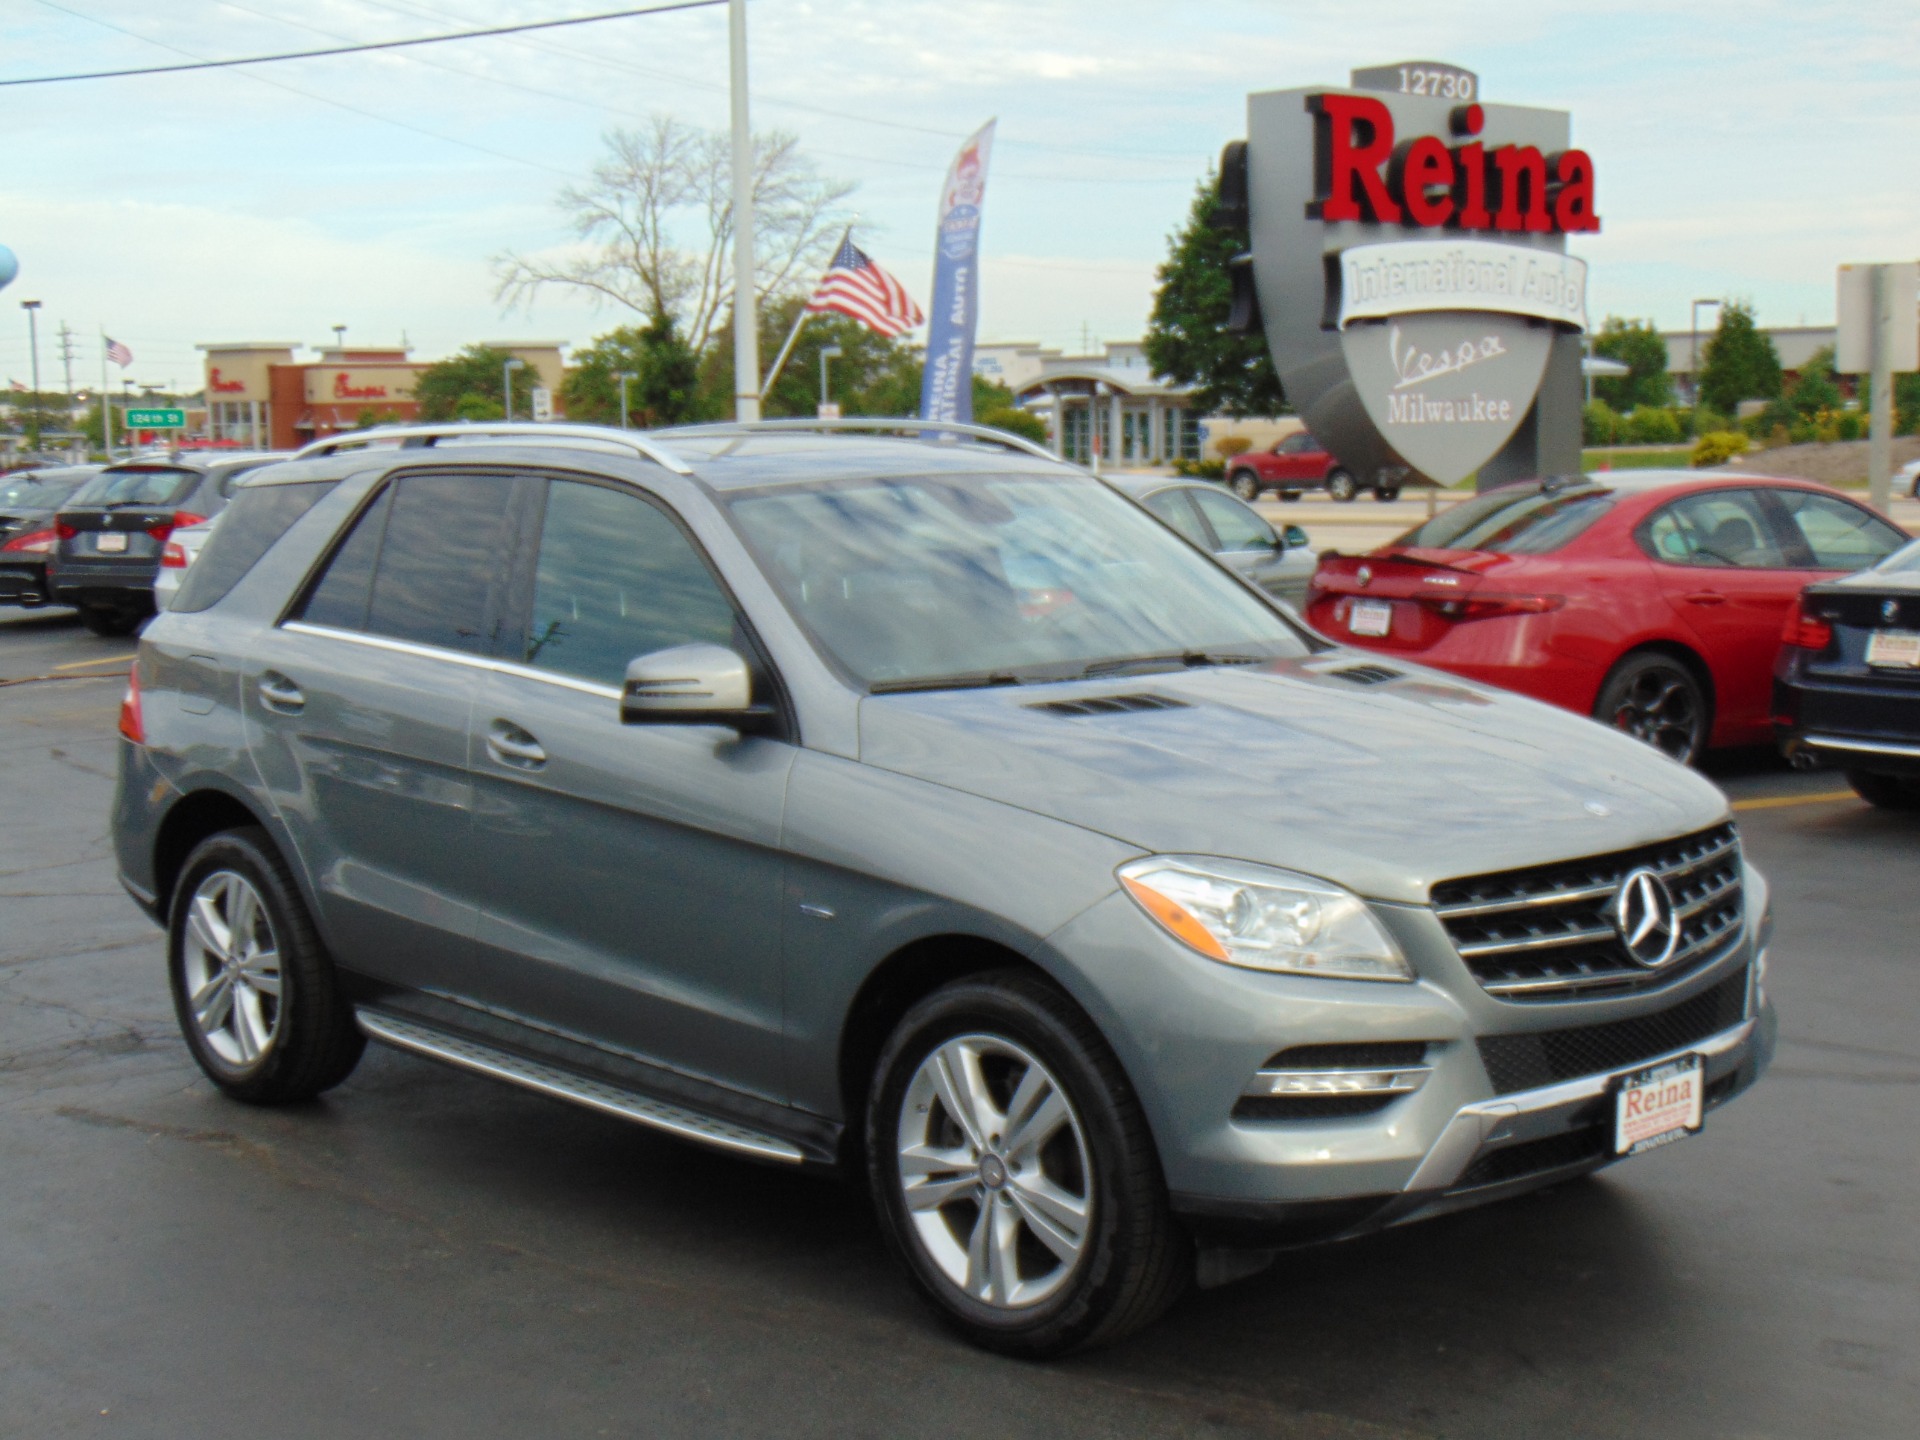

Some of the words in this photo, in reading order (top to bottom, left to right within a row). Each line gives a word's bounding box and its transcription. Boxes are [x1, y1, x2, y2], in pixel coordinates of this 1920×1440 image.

[1400, 68, 1472, 99] 12730
[1321, 93, 1602, 233] Reina
[950, 267, 969, 325] AUTO
[1351, 250, 1517, 304] International
[1522, 259, 1580, 311] Auto
[1390, 325, 1506, 388] Vespa
[1387, 393, 1511, 423] Milwaukee
[1625, 1078, 1692, 1119] Reina
